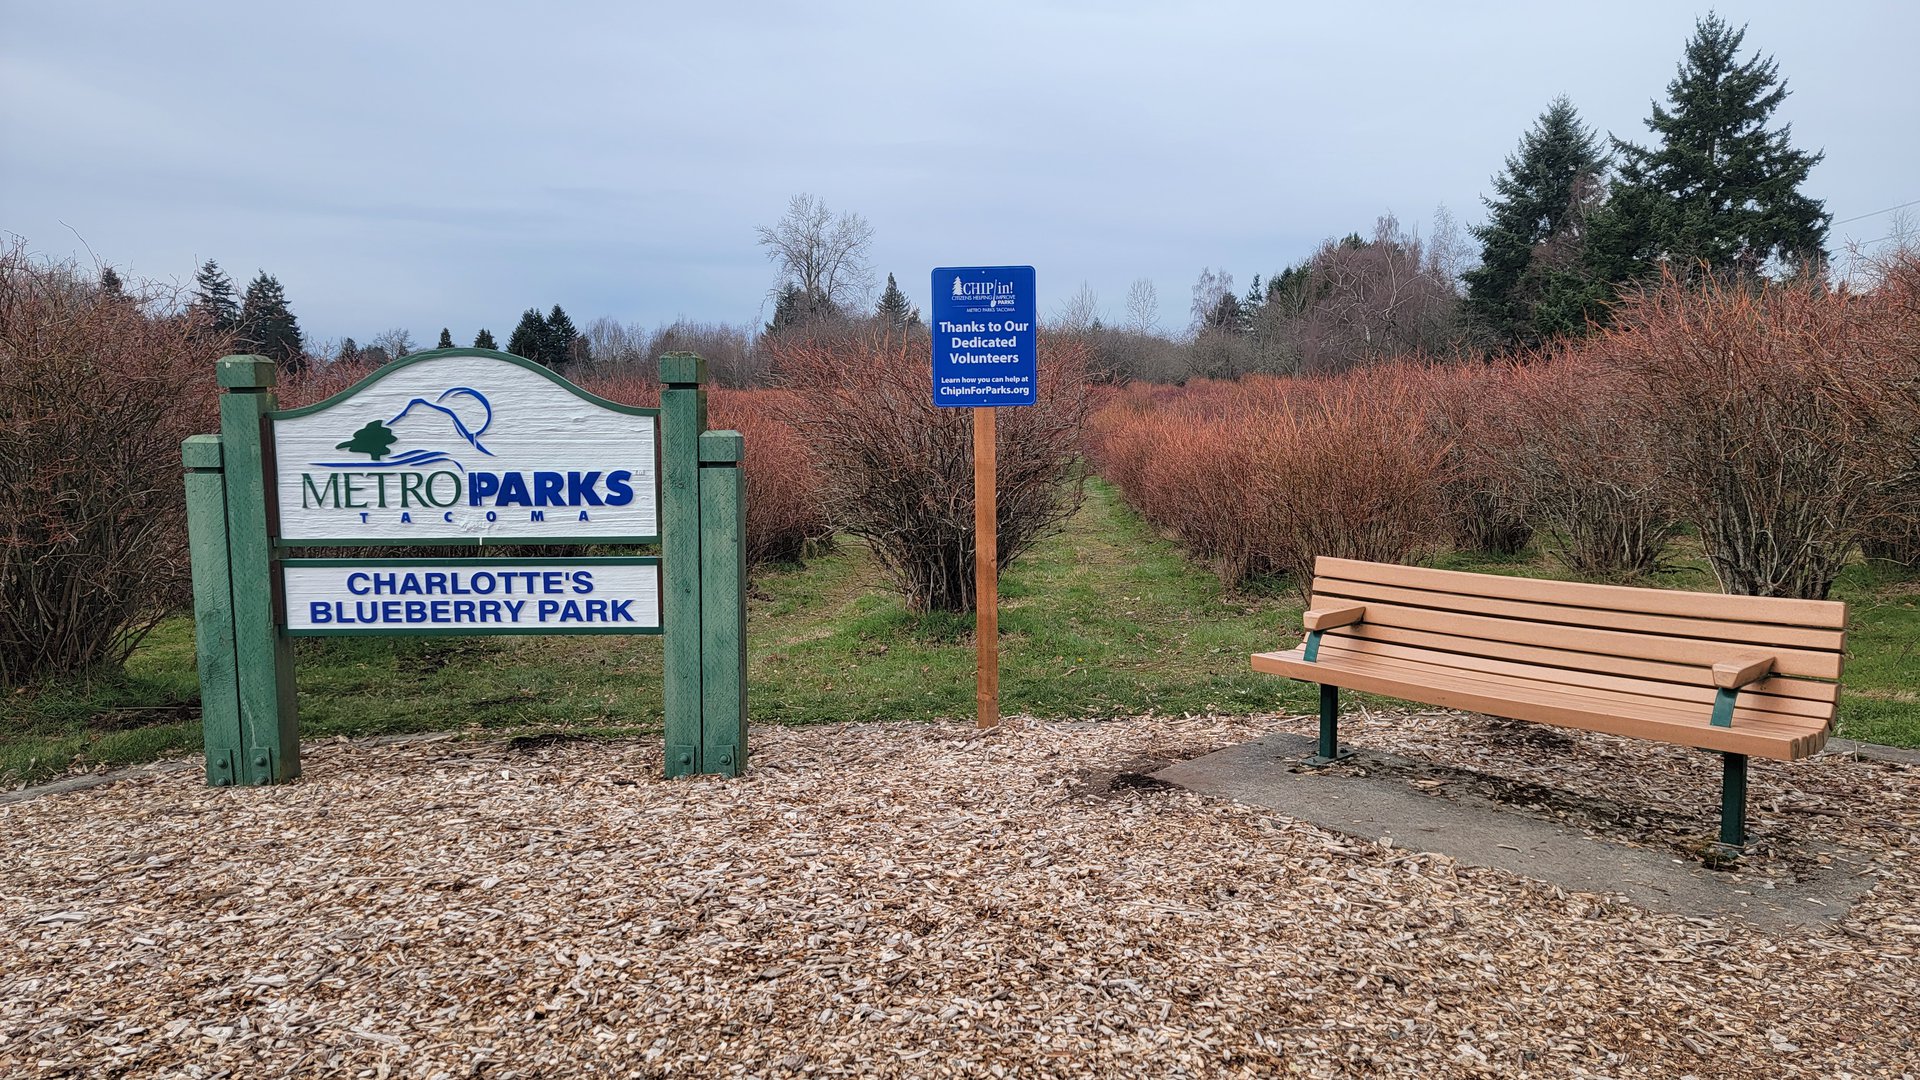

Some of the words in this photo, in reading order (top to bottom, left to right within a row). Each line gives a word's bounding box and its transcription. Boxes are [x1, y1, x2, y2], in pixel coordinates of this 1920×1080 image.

[963, 282, 994, 295] CHIP
[939, 321, 986, 333] Thanks
[988, 321, 1002, 332] to
[1004, 320, 1029, 332] Our
[952, 336, 1017, 348] Dedicated
[949, 352, 1019, 364] Volunteers
[940, 386, 1030, 397] ChipInForParks.org
[346, 570, 594, 595] CHARLOTTE'S
[310, 599, 526, 624] BLUEBERRY
[537, 599, 635, 623] PARK
